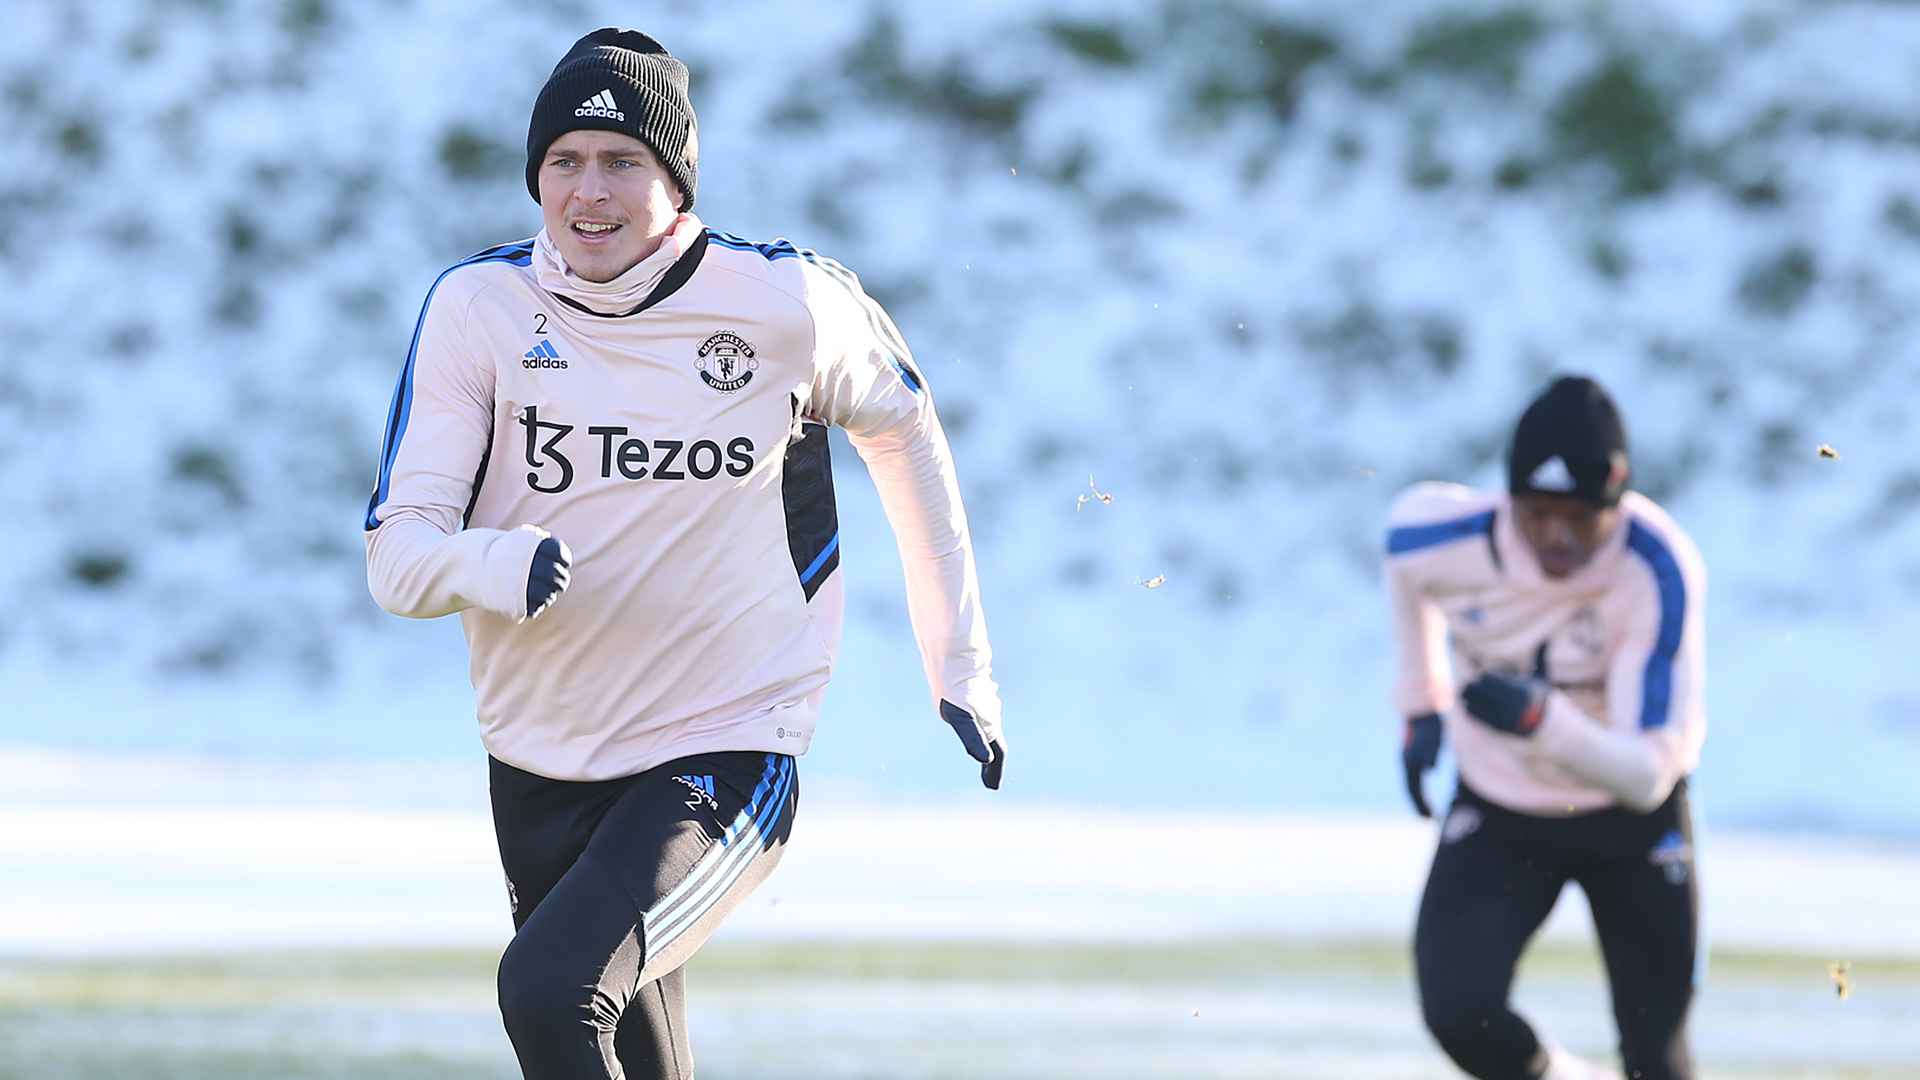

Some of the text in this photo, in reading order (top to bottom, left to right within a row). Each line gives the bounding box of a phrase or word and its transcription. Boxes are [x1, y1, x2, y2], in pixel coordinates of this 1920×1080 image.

[575, 107, 625, 122] adidas
[534, 313, 548, 334] 2
[700, 333, 753, 356] MANCHESTER
[522, 356, 569, 370] adidas
[708, 378, 746, 391] UNITED
[588, 426, 755, 481] Tezos
[684, 792, 702, 812] 2
